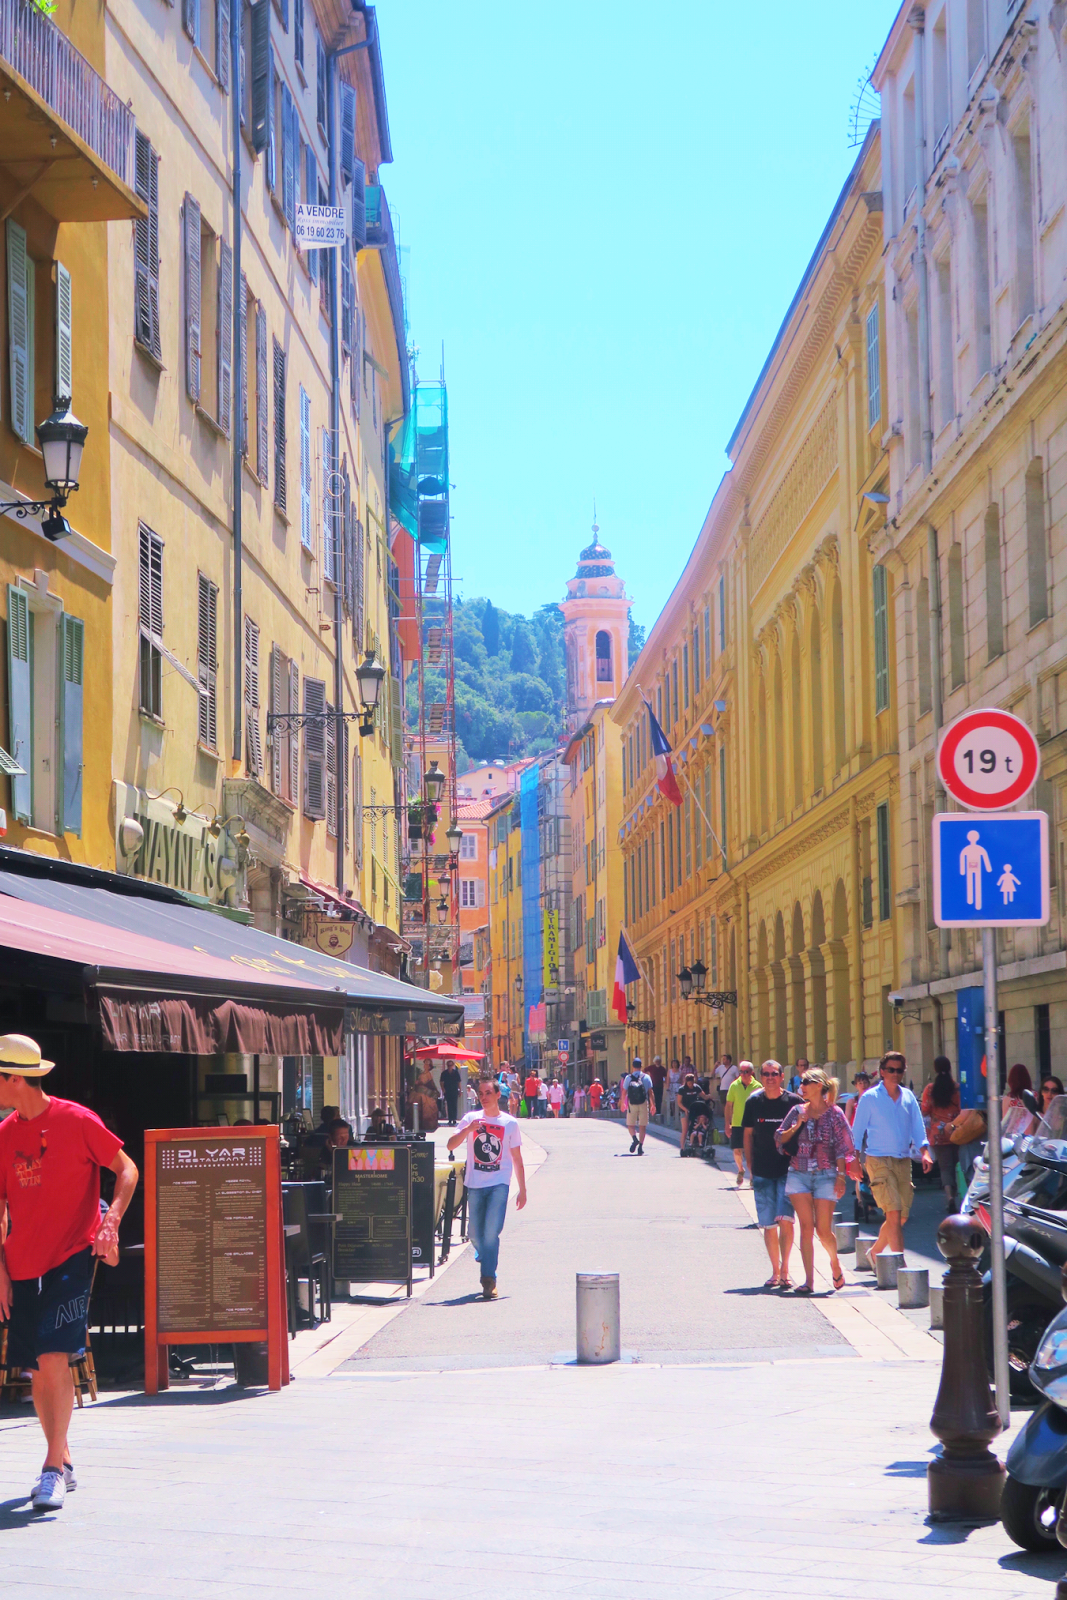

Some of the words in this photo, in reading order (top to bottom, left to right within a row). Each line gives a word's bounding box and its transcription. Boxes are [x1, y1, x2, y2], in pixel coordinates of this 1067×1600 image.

[297, 205, 304, 215] A
[306, 205, 344, 219] VENDRE
[296, 224, 305, 235] 06
[307, 226, 315, 237] 19
[316, 227, 325, 238] 60
[326, 227, 335, 239] 23
[336, 228, 345, 239] 76
[963, 749, 997, 774] 19
[1004, 756, 1014, 773] t
[133, 812, 217, 896] WAYNE'S
[178, 1149, 197, 1159] DI
[205, 1147, 246, 1157] YAR
[19, 1175, 42, 1188] WIN
[55, 1295, 86, 1329] AIR
